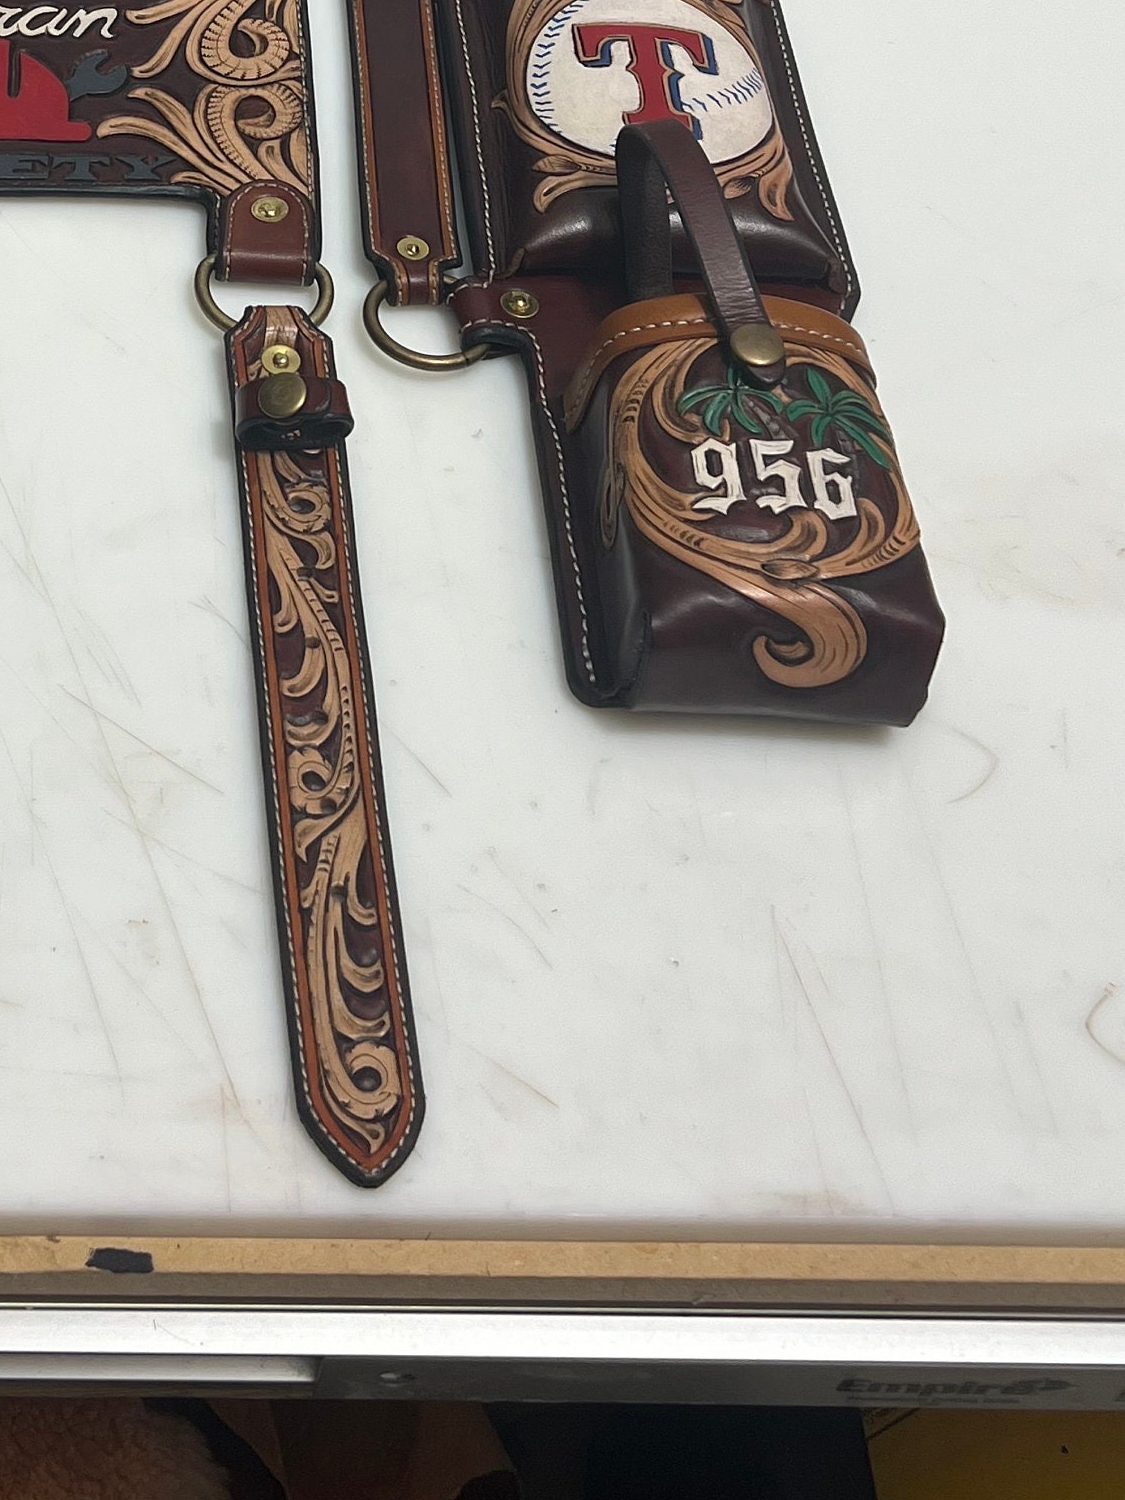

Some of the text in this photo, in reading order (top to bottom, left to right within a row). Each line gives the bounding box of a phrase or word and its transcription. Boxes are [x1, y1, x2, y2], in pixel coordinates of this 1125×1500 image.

[572, 21, 719, 140] T
[691, 438, 857, 519] 956
[836, 1379, 1037, 1397] Empire
